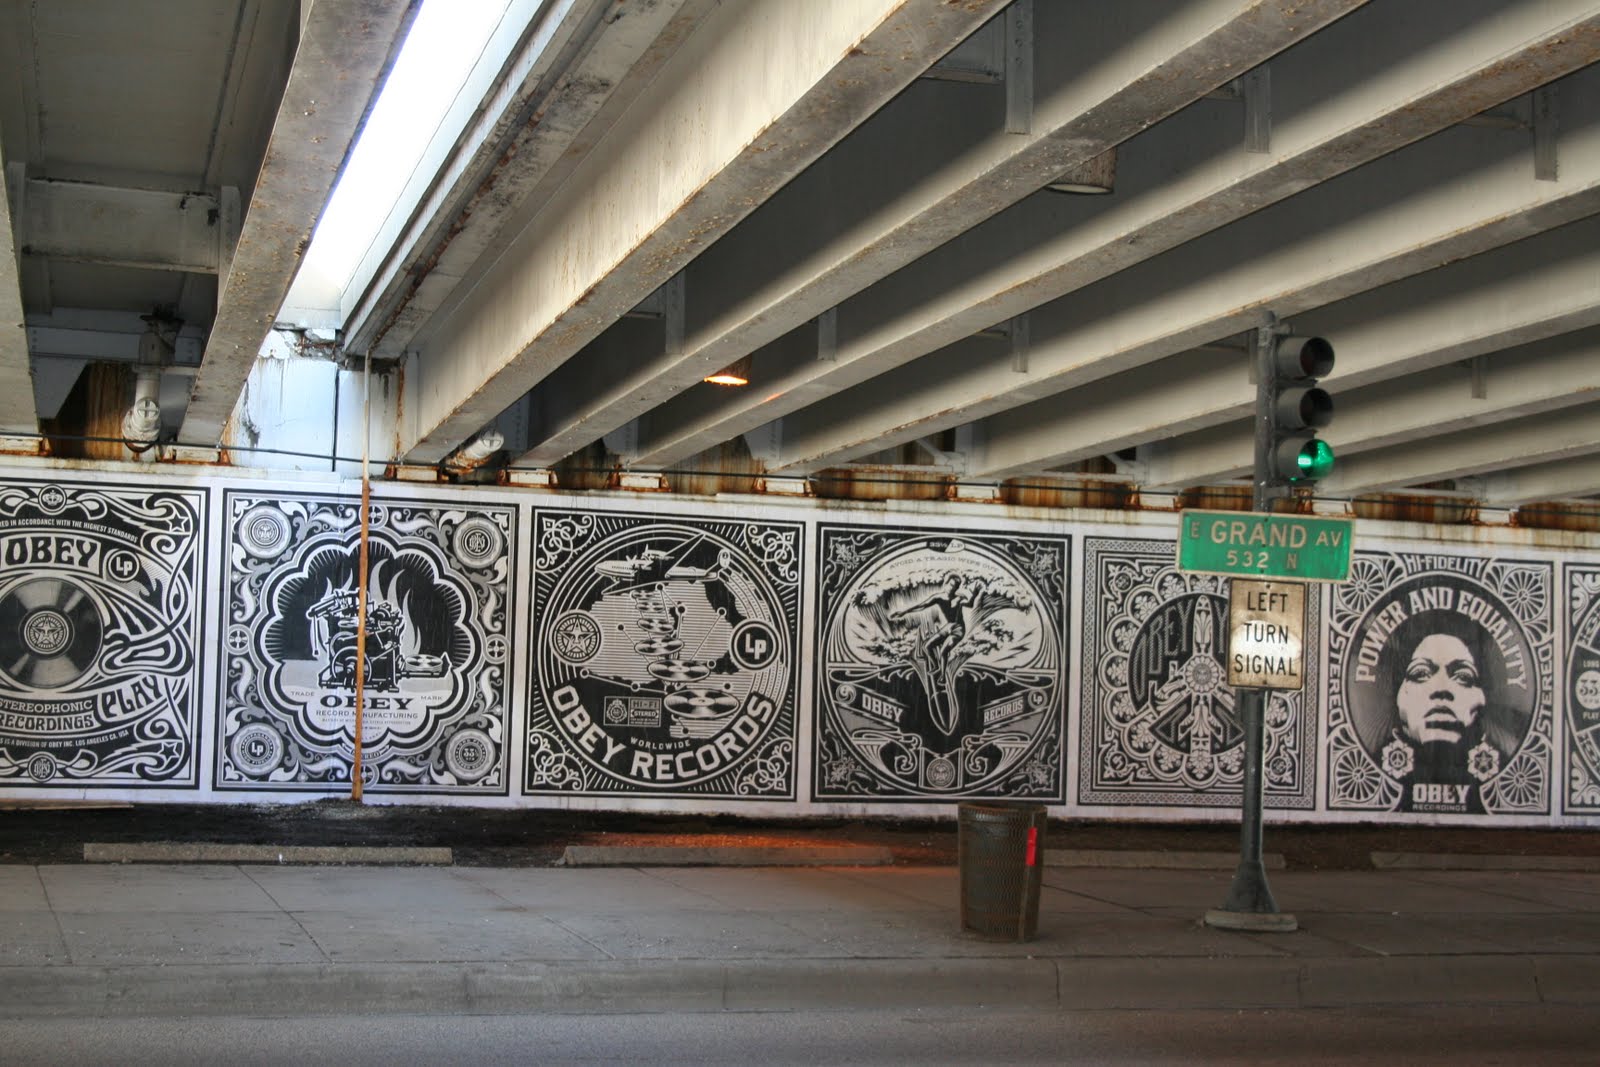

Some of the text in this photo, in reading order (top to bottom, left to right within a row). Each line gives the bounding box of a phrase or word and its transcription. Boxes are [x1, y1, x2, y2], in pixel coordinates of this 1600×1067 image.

[72, 520, 82, 528] THE
[83, 522, 107, 533] HIGHEST
[108, 527, 138, 543] STANDARDS
[1190, 520, 1342, 548] E GRAND AV
[5, 536, 98, 568] OBEY
[1226, 550, 1297, 570] 532 N
[1402, 554, 1488, 578] HI-FIDELITY
[1247, 591, 1288, 613] LEFT
[1244, 622, 1289, 644] TURN
[1355, 586, 1527, 690] POWER AND EQUALITY
[1234, 653, 1297, 676] SIGNAL
[1329, 630, 1346, 728] STEREO
[1536, 643, 1553, 738] STEREO
[101, 675, 163, 719] PLAY
[320, 694, 415, 710] OBEY
[862, 693, 904, 723] OBEY
[352, 711, 418, 720] MNUFACTURING
[983, 699, 1024, 723] RECORDS
[86, 736, 109, 745] ANGELES
[118, 729, 130, 738] USA
[552, 685, 774, 780] OBEY RECORDS
[630, 736, 691, 750] WORLDWIDE
[1412, 783, 1471, 804] OBEY
[1412, 803, 1467, 812] RECORDINGS
